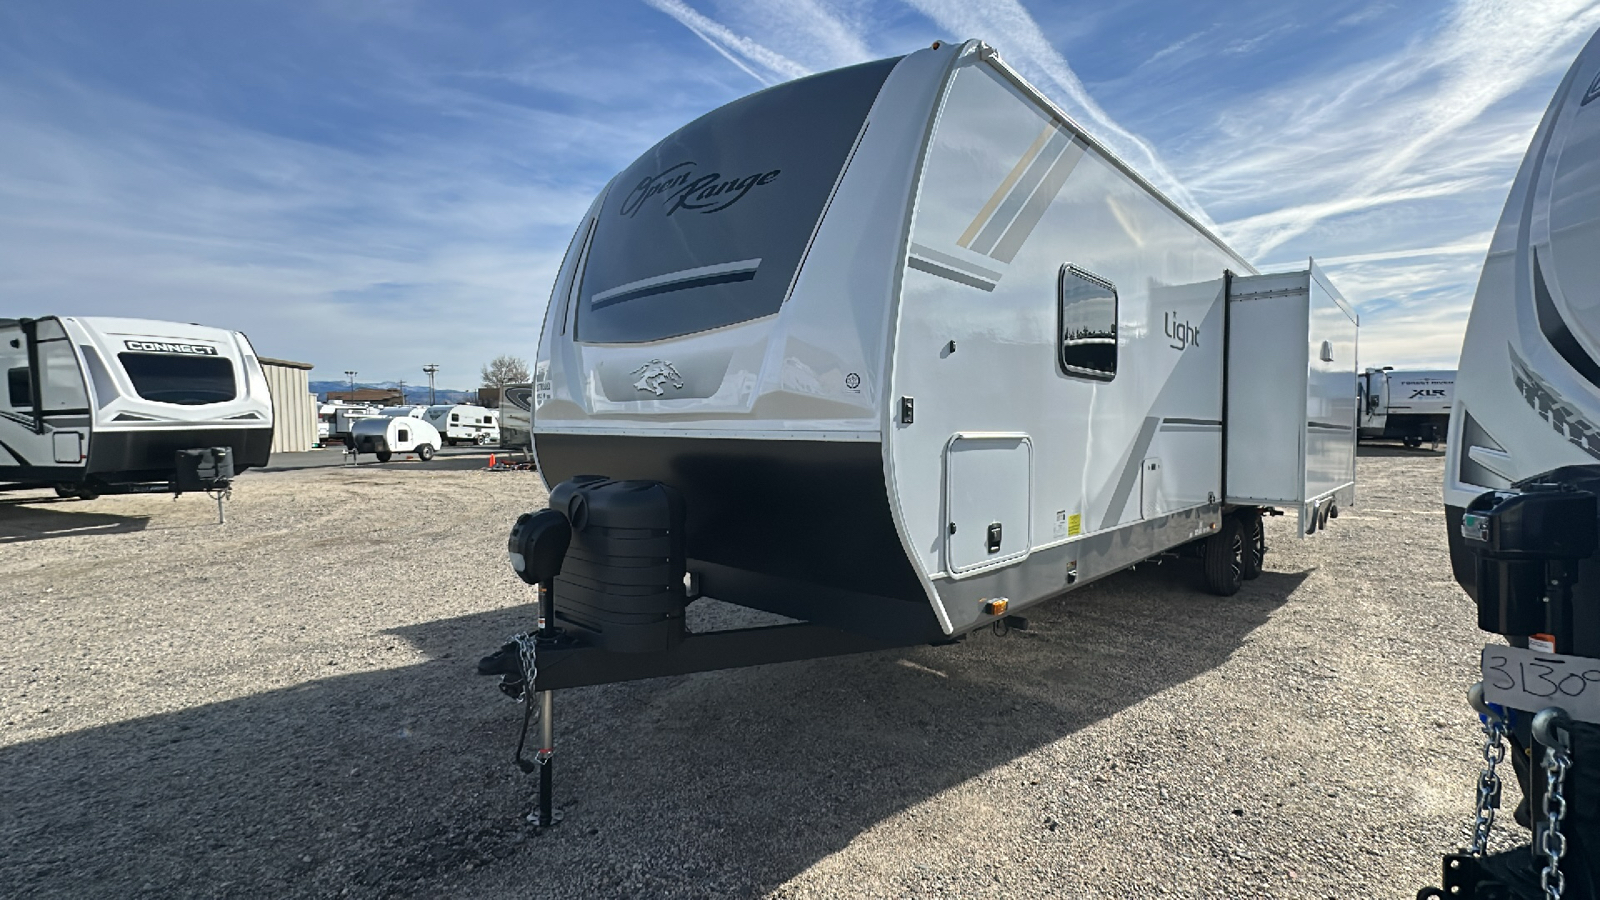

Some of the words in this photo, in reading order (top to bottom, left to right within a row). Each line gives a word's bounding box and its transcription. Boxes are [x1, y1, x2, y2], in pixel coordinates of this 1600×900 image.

[620, 161, 697, 218] Open
[663, 169, 782, 217] Range
[1164, 310, 1200, 351] Light
[127, 341, 214, 355] CONNECT
[1408, 389, 1447, 399] XLR
